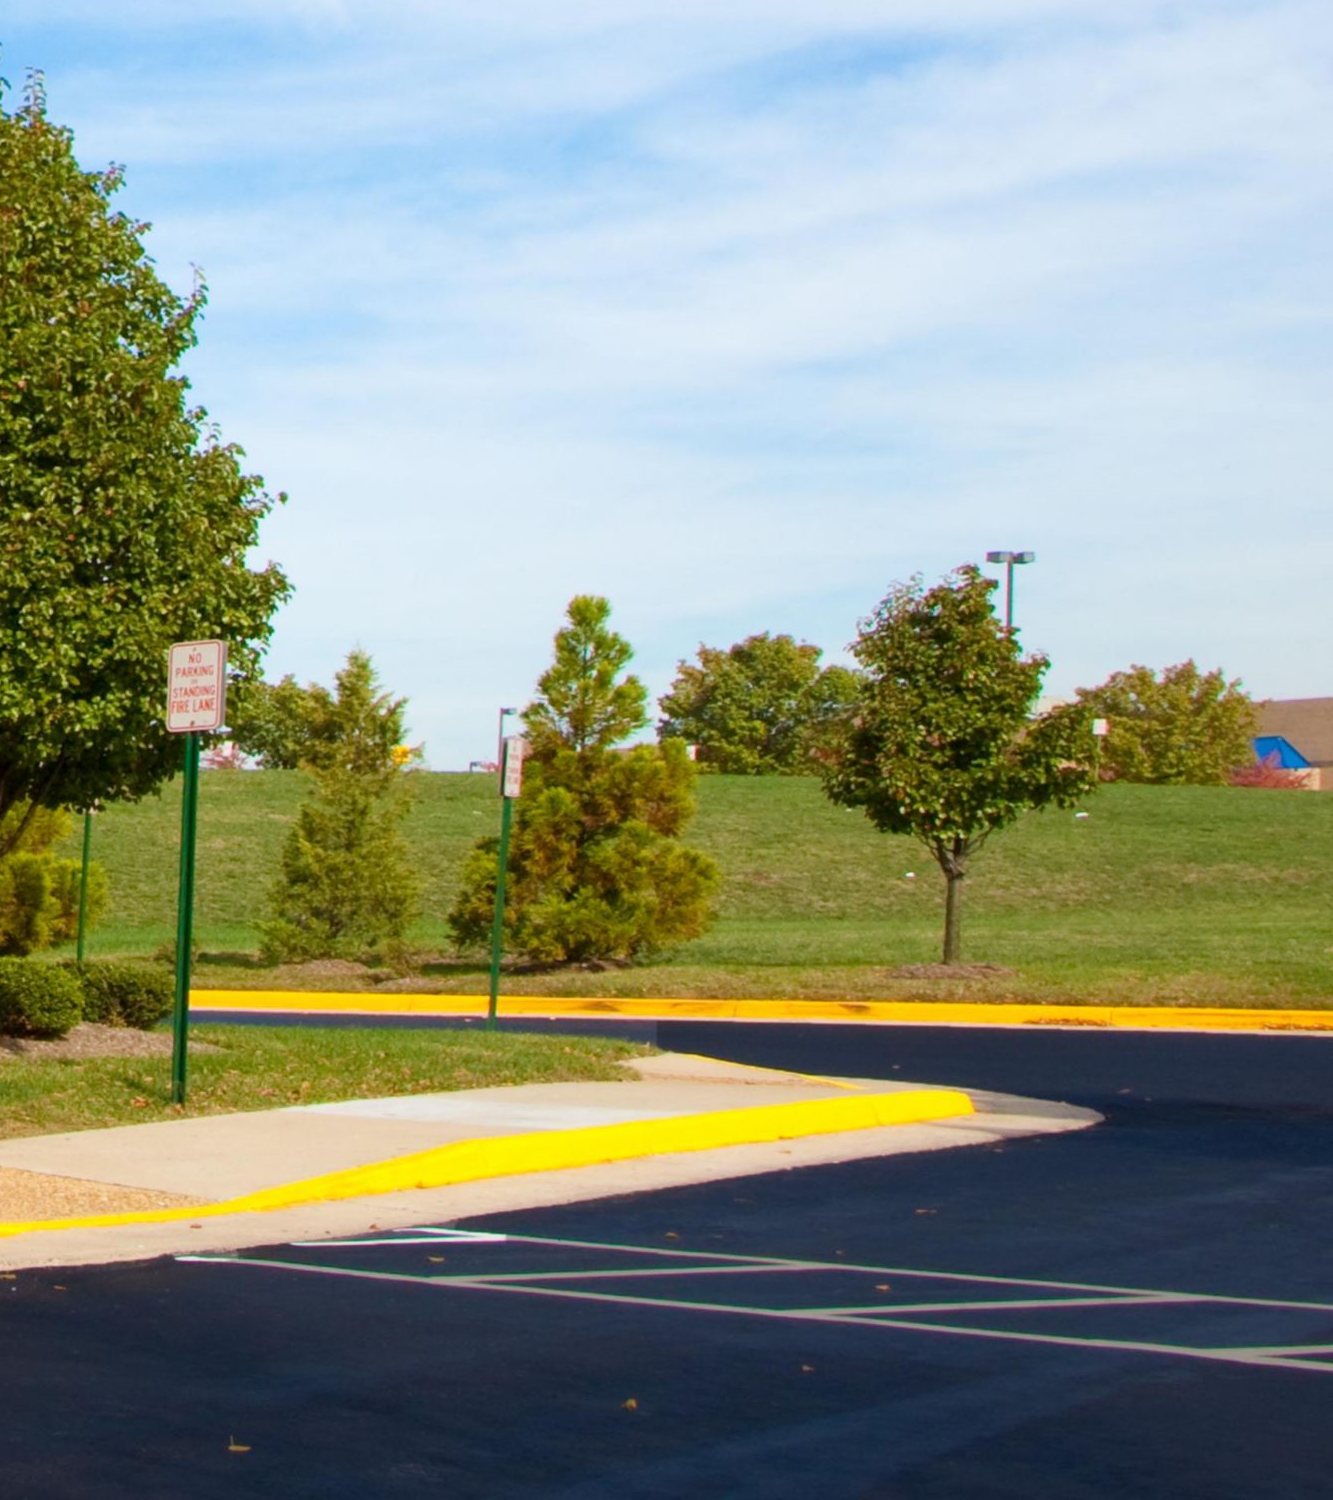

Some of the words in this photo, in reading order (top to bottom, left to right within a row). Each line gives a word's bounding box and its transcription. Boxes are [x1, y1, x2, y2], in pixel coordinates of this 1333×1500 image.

[188, 653, 202, 663] NO
[175, 665, 214, 677] PARKING
[173, 685, 216, 698] STANDING
[171, 701, 189, 713] FIRE
[193, 698, 215, 712] LANE
